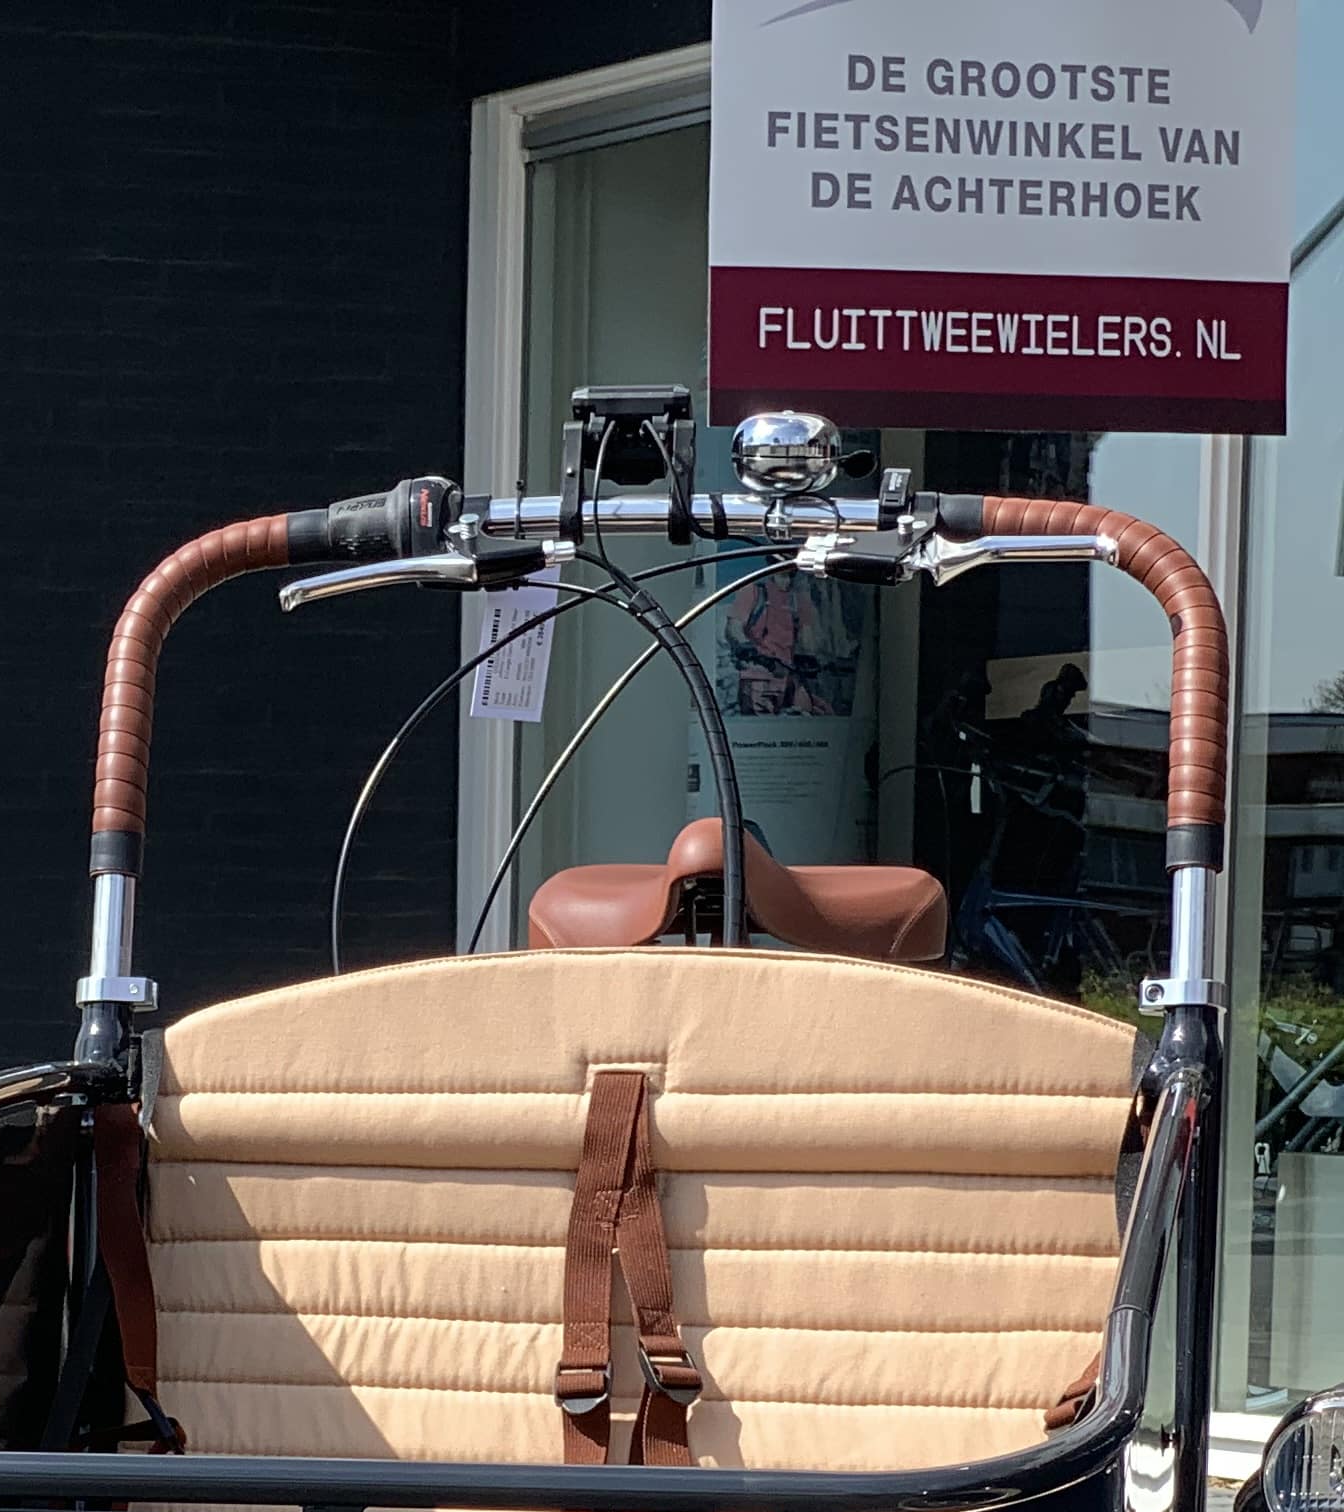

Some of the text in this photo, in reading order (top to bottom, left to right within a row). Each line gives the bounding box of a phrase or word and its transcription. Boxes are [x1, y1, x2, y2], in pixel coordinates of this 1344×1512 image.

[847, 53, 1172, 105] DE GROOTSTE
[766, 110, 1241, 166] FIETSENWINKEL VAN
[810, 171, 1202, 222] DE ACHTERHOEK
